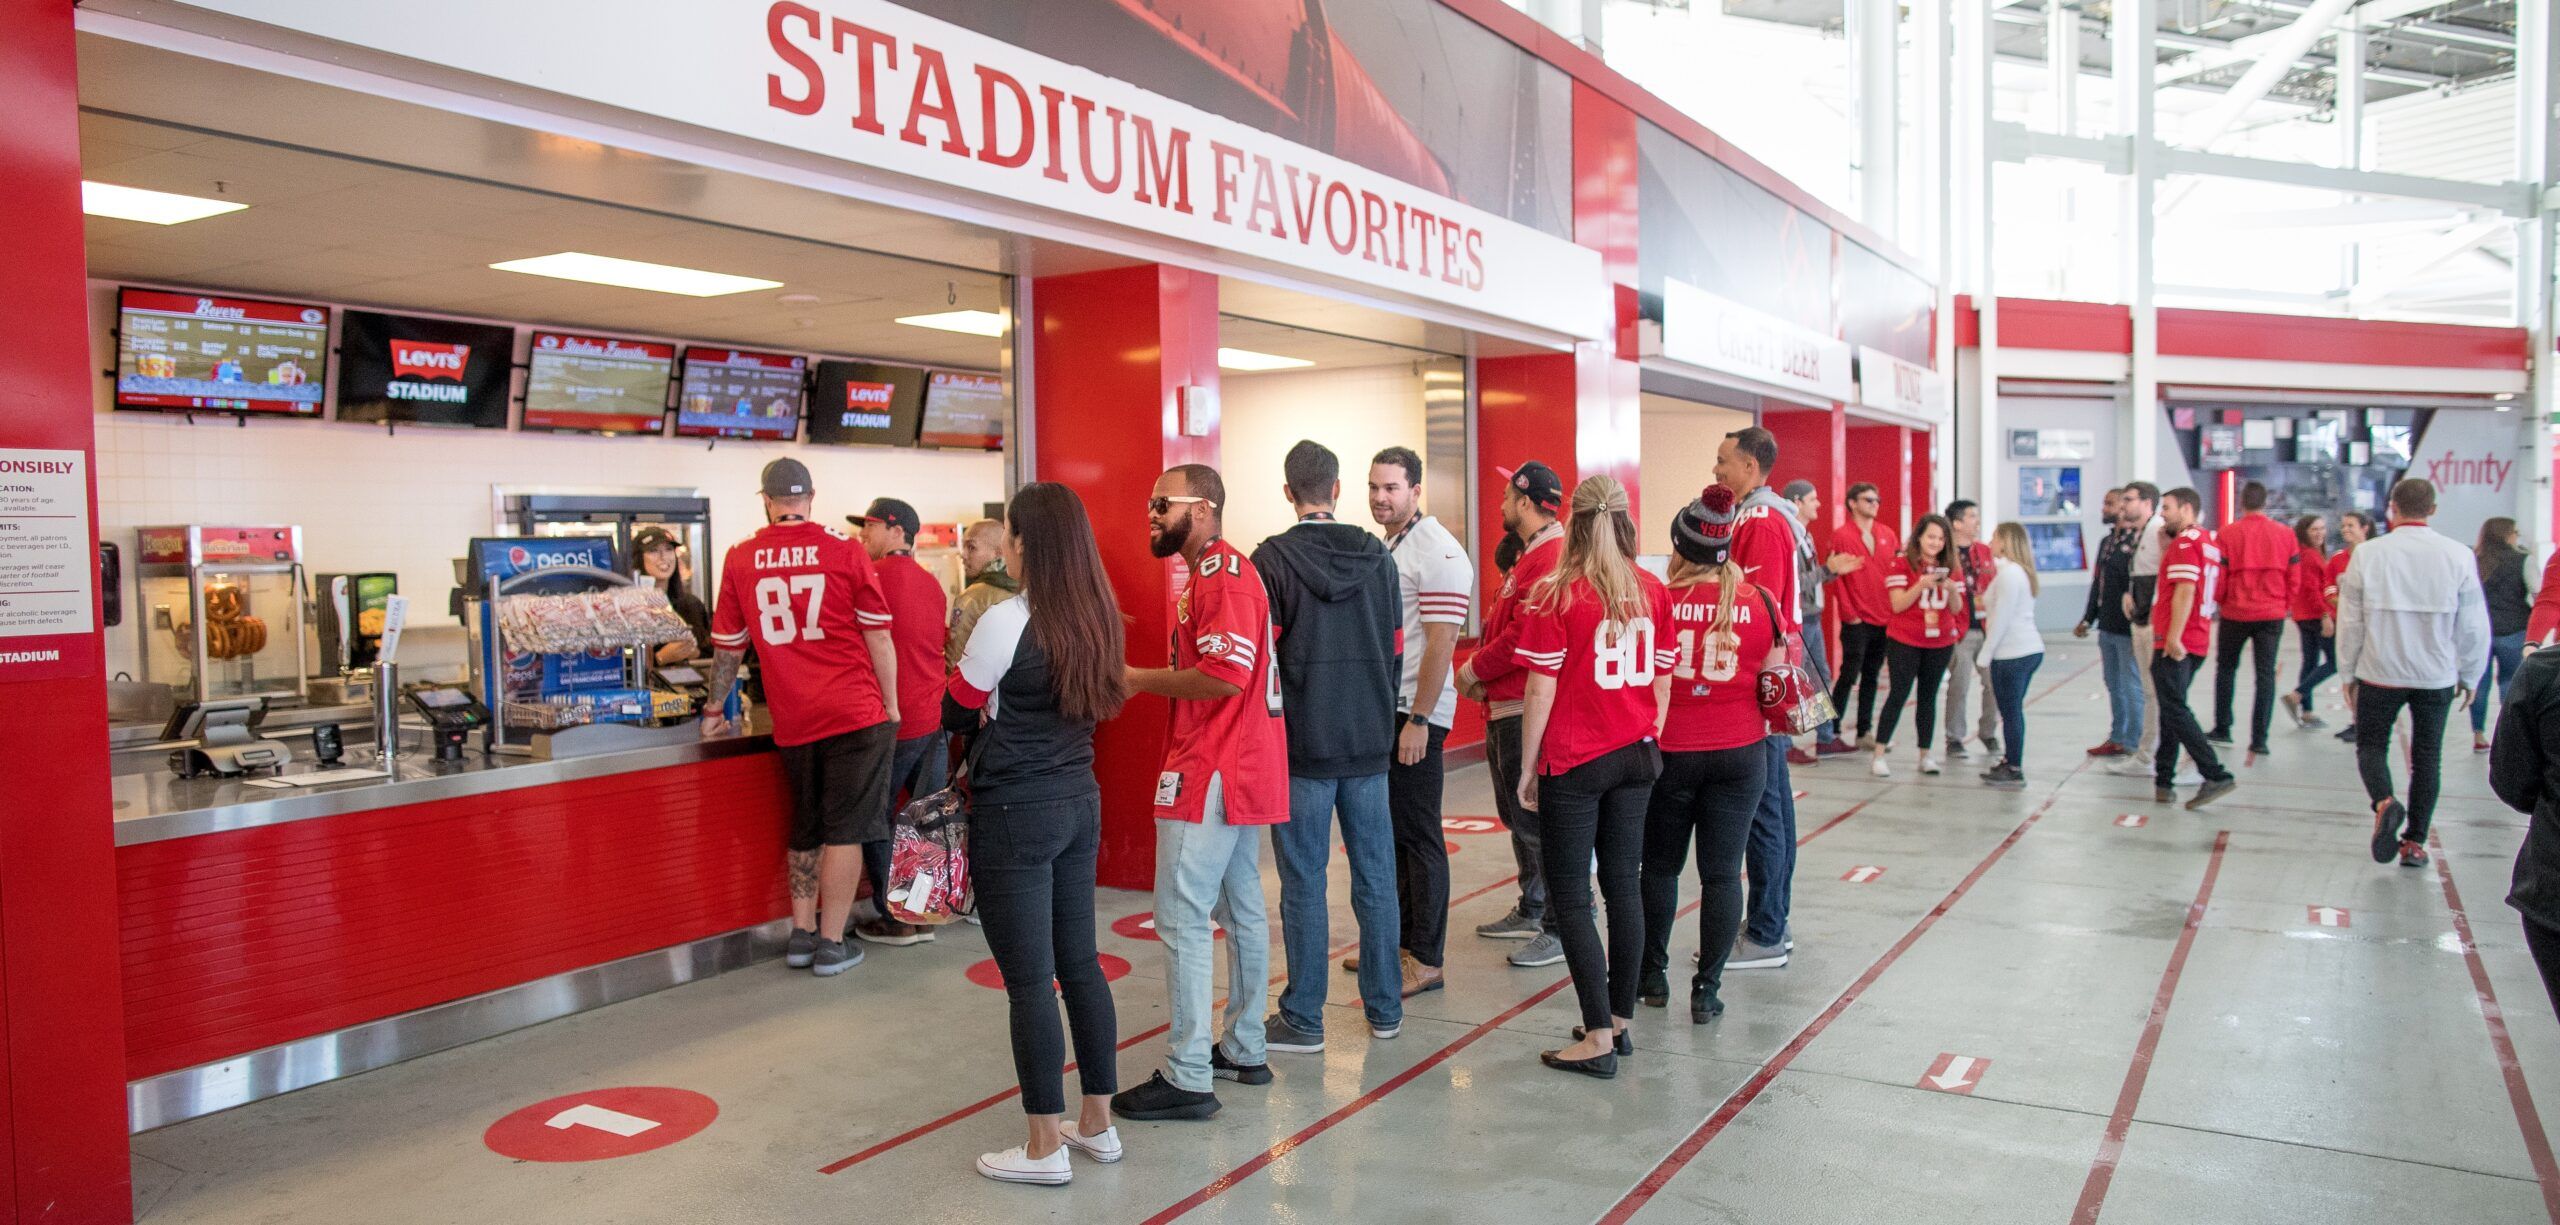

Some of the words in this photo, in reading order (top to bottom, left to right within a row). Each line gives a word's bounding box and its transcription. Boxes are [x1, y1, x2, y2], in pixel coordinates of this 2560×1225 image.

[766, 0, 1195, 216] STADIUM
[1209, 140, 1486, 293] FAVORITES
[1782, 334, 1821, 381] BEER
[387, 381, 468, 403] STADIUM
[841, 412, 891, 429] STADIUM
[2427, 451, 2513, 493] xfinity
[754, 546, 819, 570] CLARK
[1200, 553, 1241, 578] 81
[40, 608, 77, 616] beverages
[755, 573, 826, 646] 87
[1671, 603, 1751, 624] MONTNA
[1594, 617, 1655, 690] 80
[1673, 629, 1742, 682] 16
[544, 1103, 662, 1138] 1
